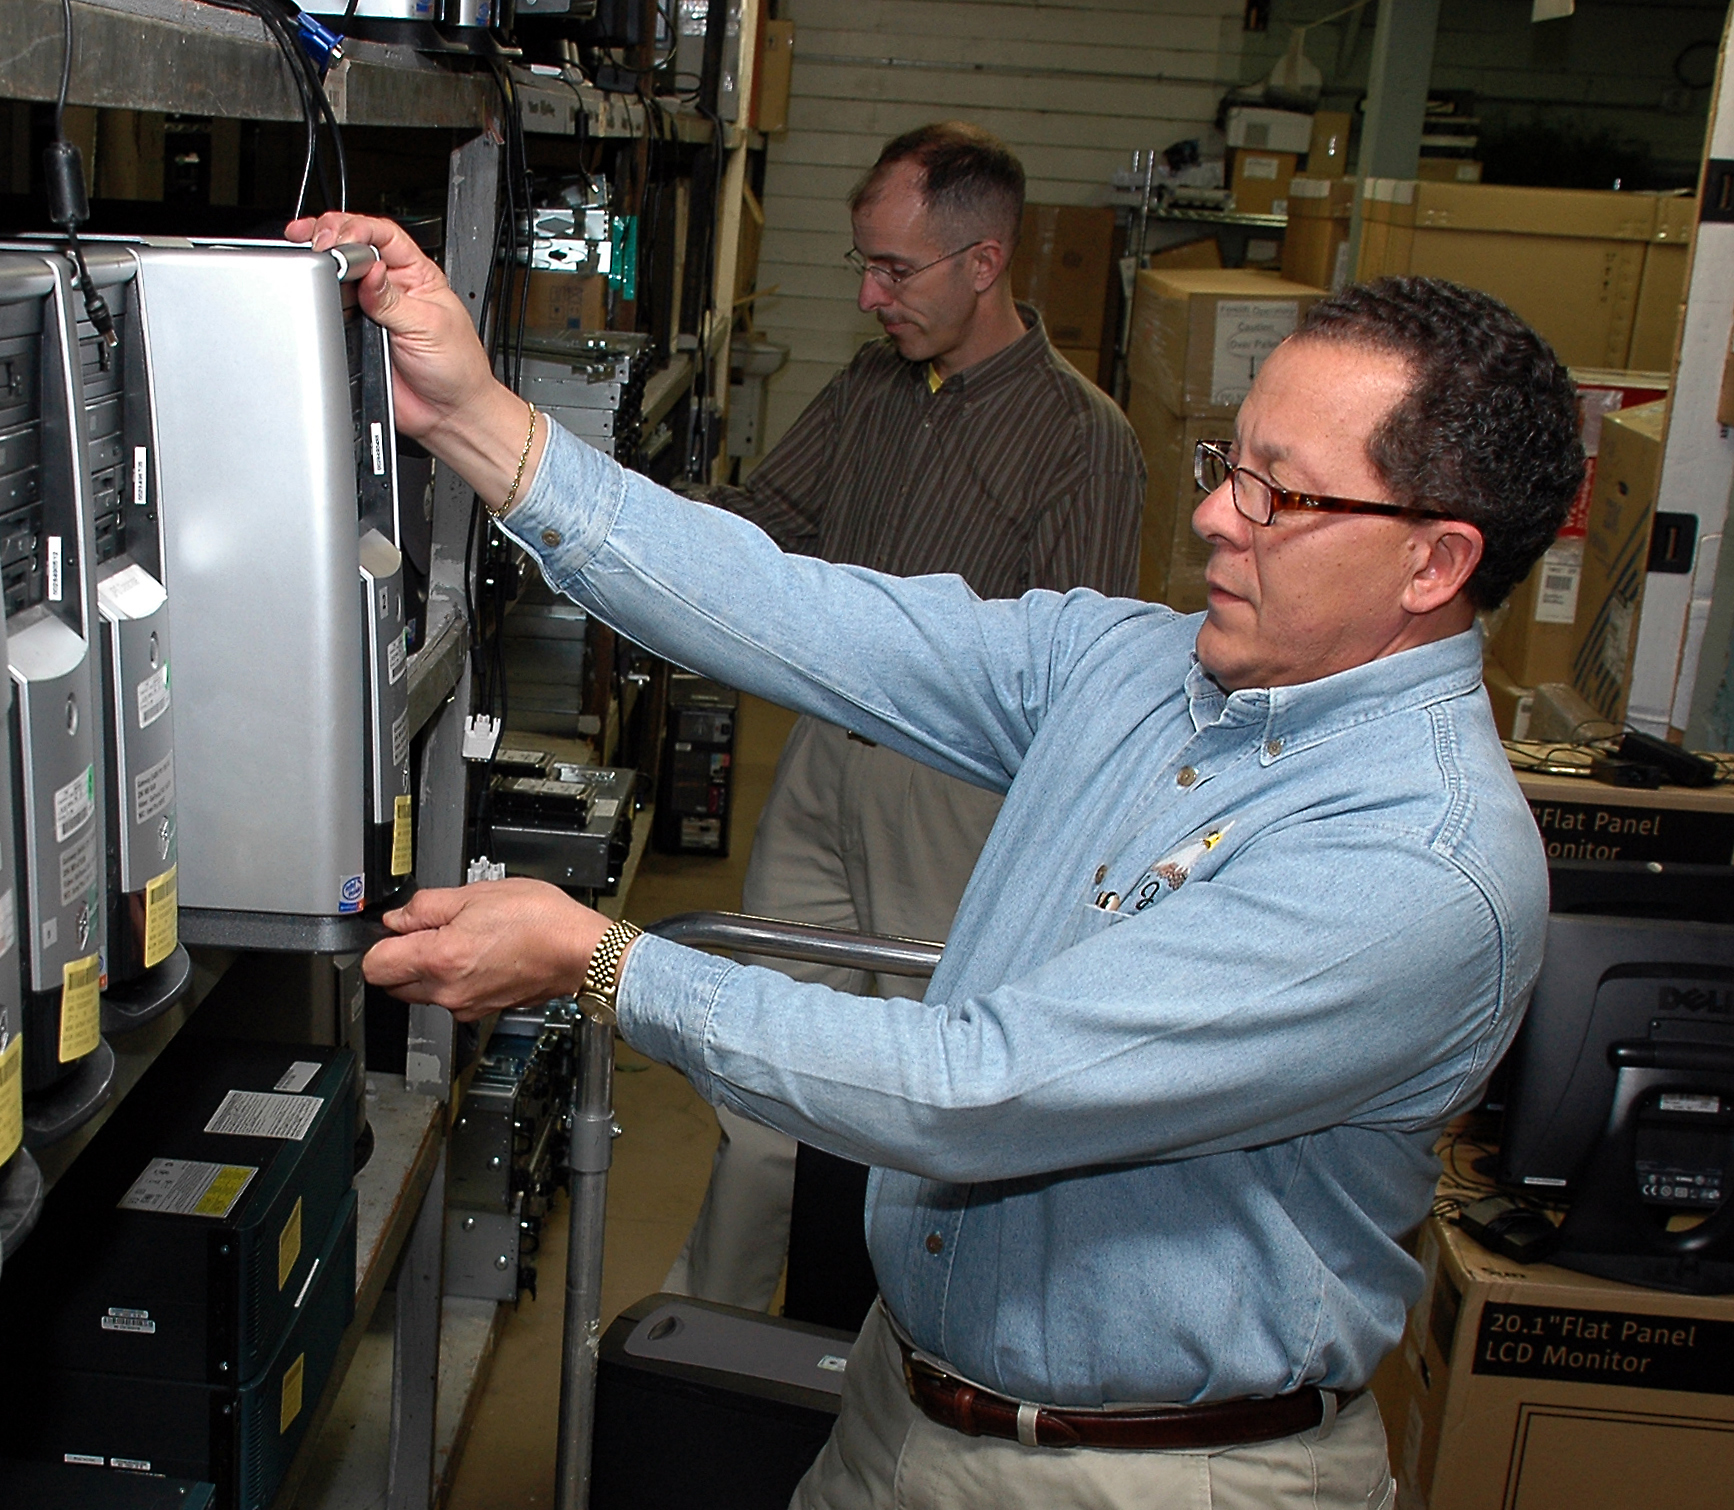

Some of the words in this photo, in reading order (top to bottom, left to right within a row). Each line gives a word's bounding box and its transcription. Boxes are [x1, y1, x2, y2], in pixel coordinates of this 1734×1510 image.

[1594, 811, 1661, 836] Panel
[1544, 838, 1621, 860] onitor
[1621, 1321, 1697, 1347] Panel
[1485, 1341, 1534, 1364] LCD
[1542, 1345, 1652, 1373] Monitor
